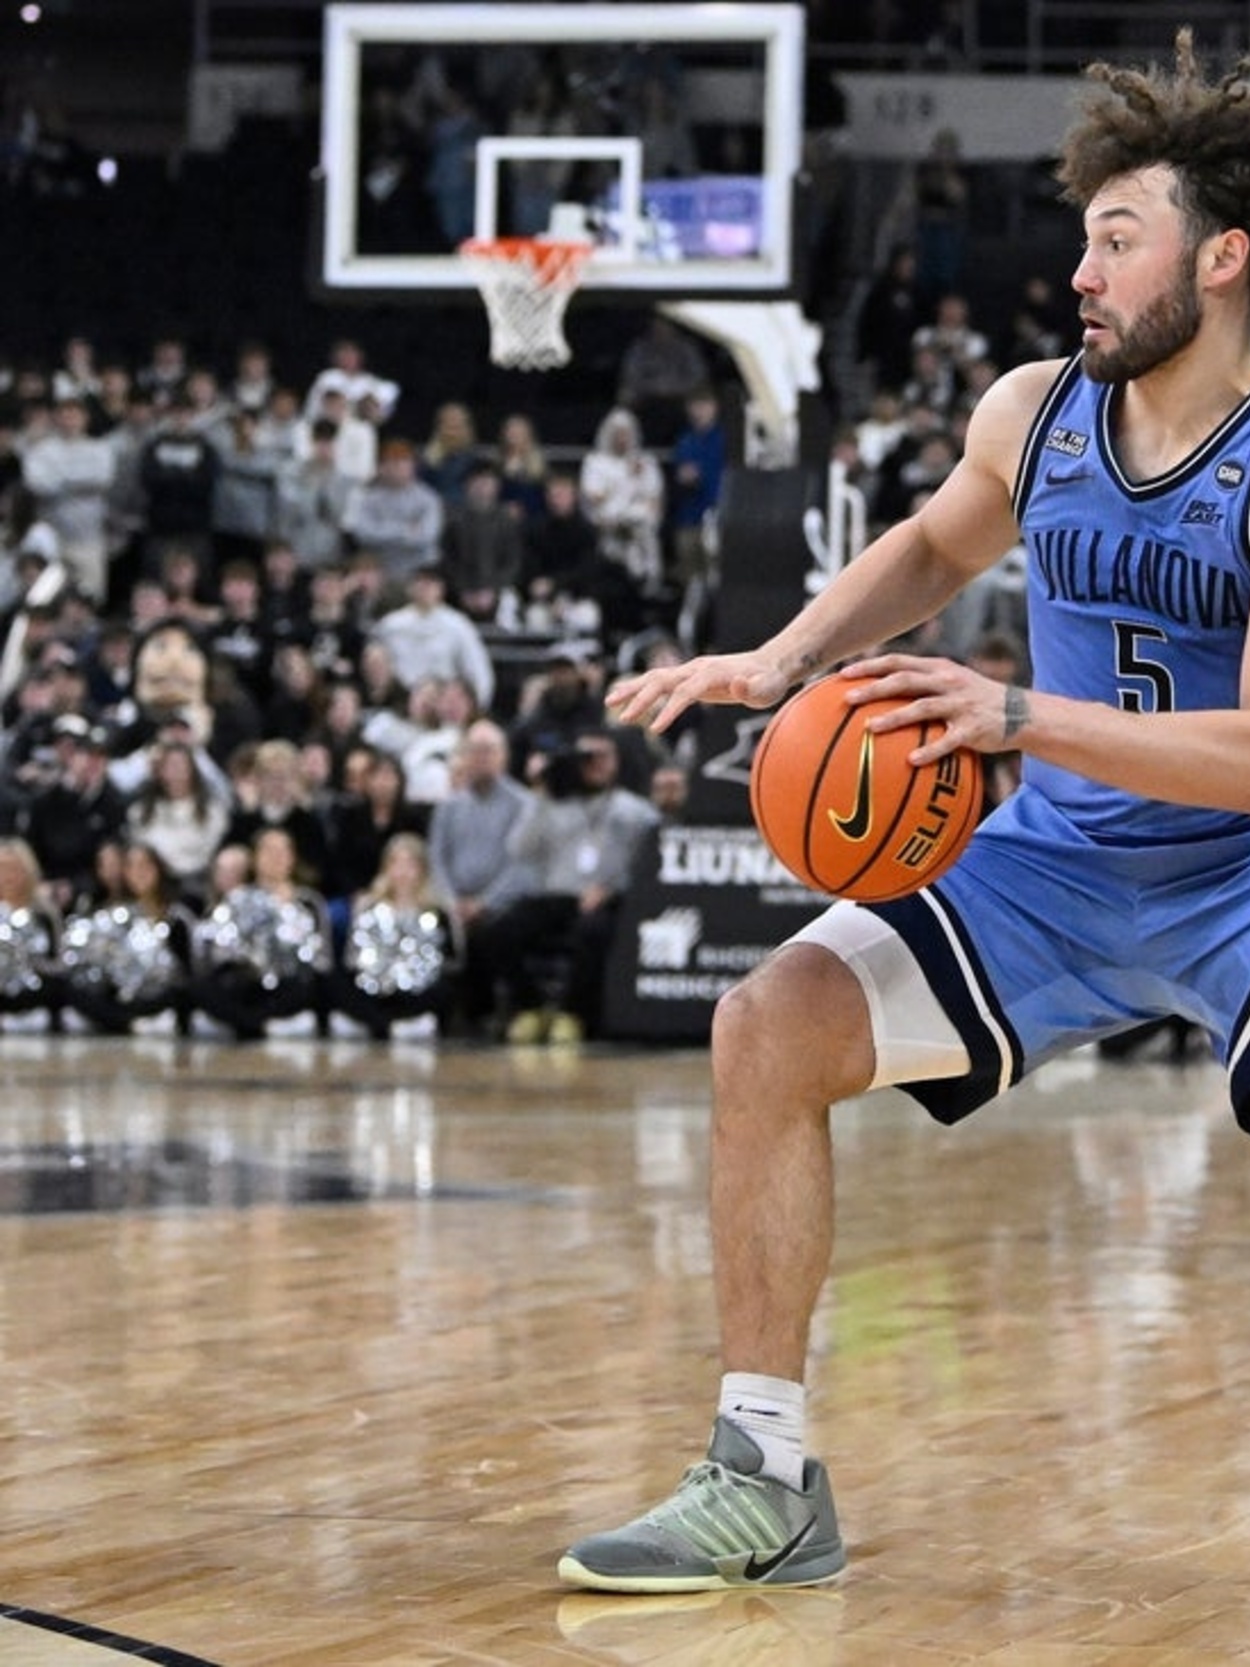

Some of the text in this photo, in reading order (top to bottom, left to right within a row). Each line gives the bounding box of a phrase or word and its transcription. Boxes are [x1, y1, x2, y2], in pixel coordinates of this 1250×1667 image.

[1182, 509, 1224, 526] EAST
[1034, 529, 1248, 629] VILLANOVA
[1111, 619, 1175, 714] 5
[895, 751, 961, 870] ELITE
